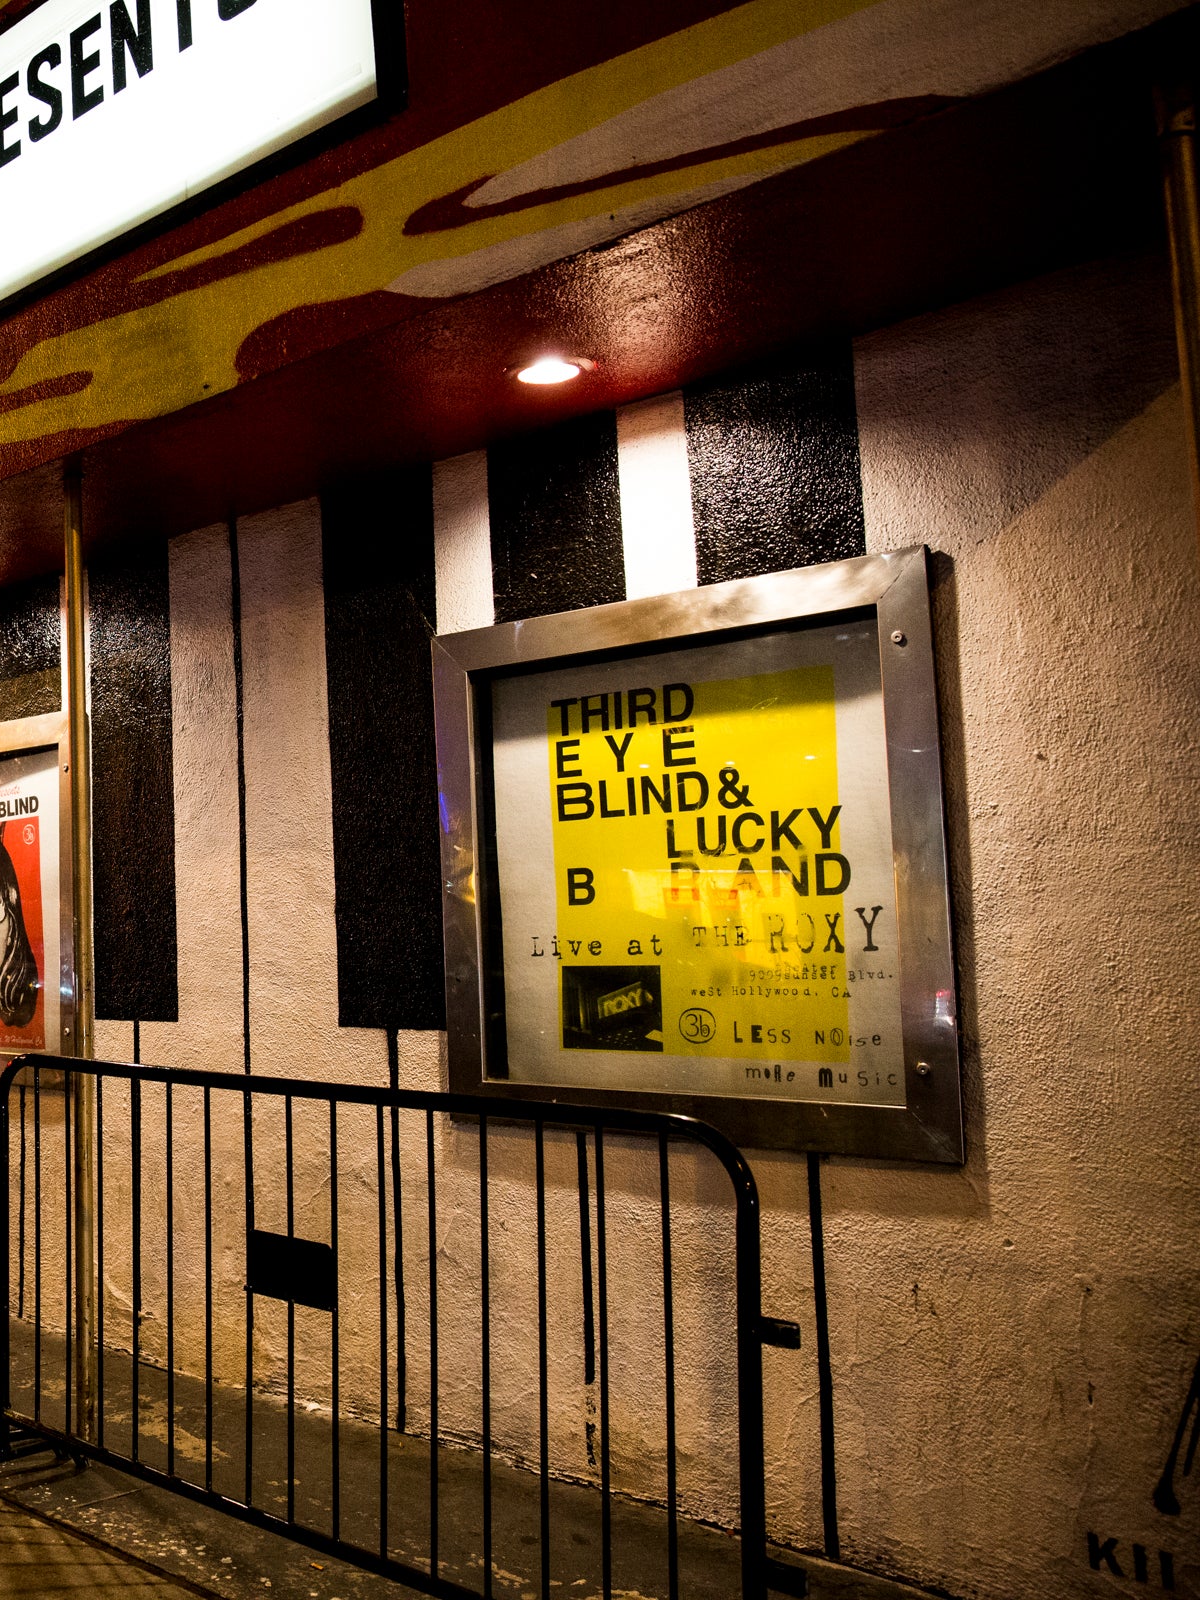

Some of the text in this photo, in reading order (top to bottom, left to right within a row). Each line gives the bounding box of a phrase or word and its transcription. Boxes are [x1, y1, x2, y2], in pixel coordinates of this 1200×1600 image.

[551, 682, 694, 736] THIRD
[556, 725, 696, 779] EYE
[556, 766, 754, 822] BLIND &
[666, 805, 842, 859] LUCKY
[531, 905, 884, 959] Live at THE ROXY
[831, 986, 852, 998] CA
